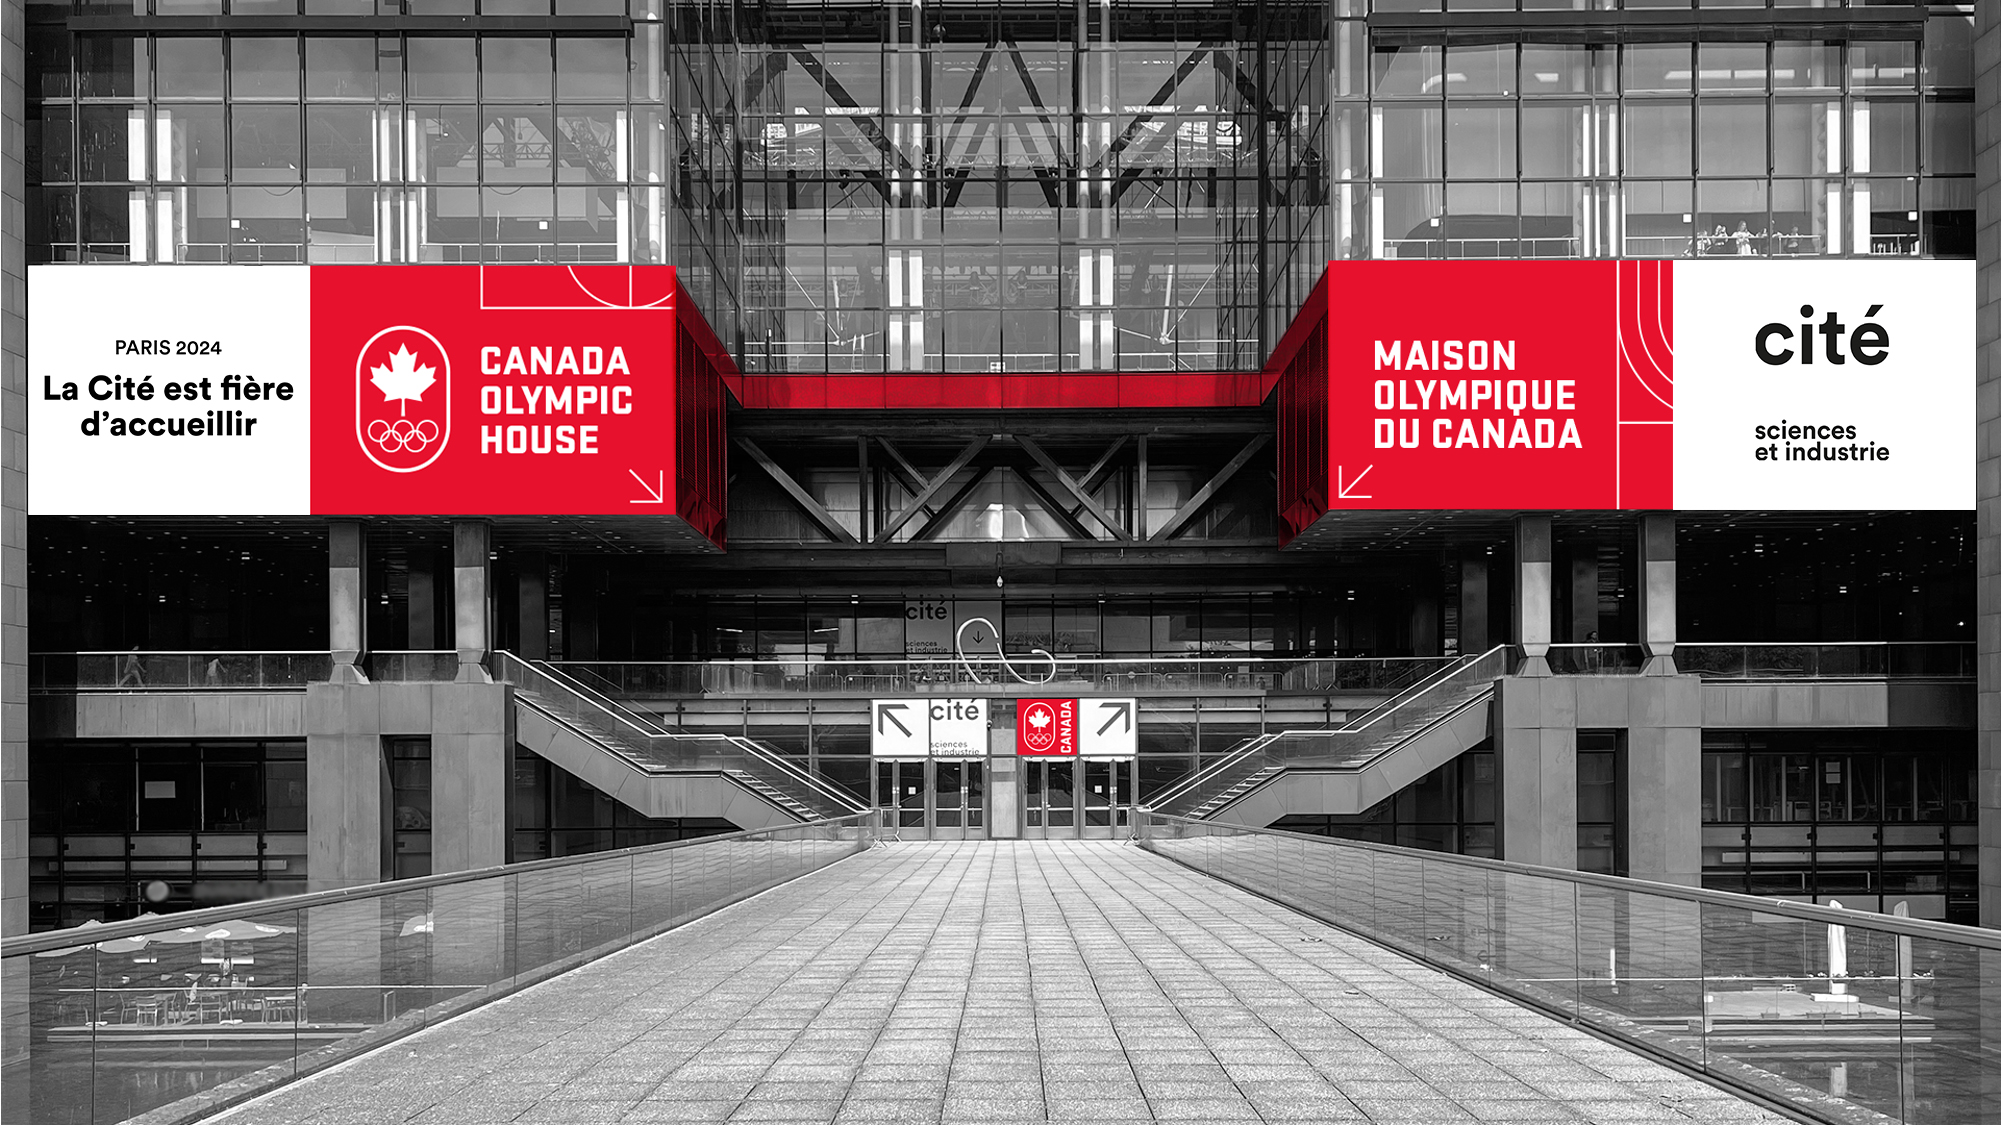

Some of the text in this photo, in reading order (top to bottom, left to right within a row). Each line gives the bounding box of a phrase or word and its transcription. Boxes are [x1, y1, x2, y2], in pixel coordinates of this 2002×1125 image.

[115, 340, 223, 356] PARIS 2024
[1755, 304, 1890, 366] cité
[480, 346, 631, 375] CANADA
[1374, 340, 1516, 370] MAISON
[43, 374, 294, 401] La Cité est fière
[480, 386, 632, 415] OLYMPIC
[1374, 379, 1576, 416] OLYMPIQUE
[80, 409, 258, 437] d’accueillir
[1374, 418, 1583, 449] DU CANADA
[1755, 419, 1857, 440] sciences
[481, 425, 599, 454] HOUSE
[1755, 441, 1890, 461] et industrie
[906, 600, 947, 620] cité
[930, 698, 979, 721] cité
[1060, 700, 1072, 754] CANADA
[931, 740, 968, 748] sciences
[941, 748, 980, 756] industrie
